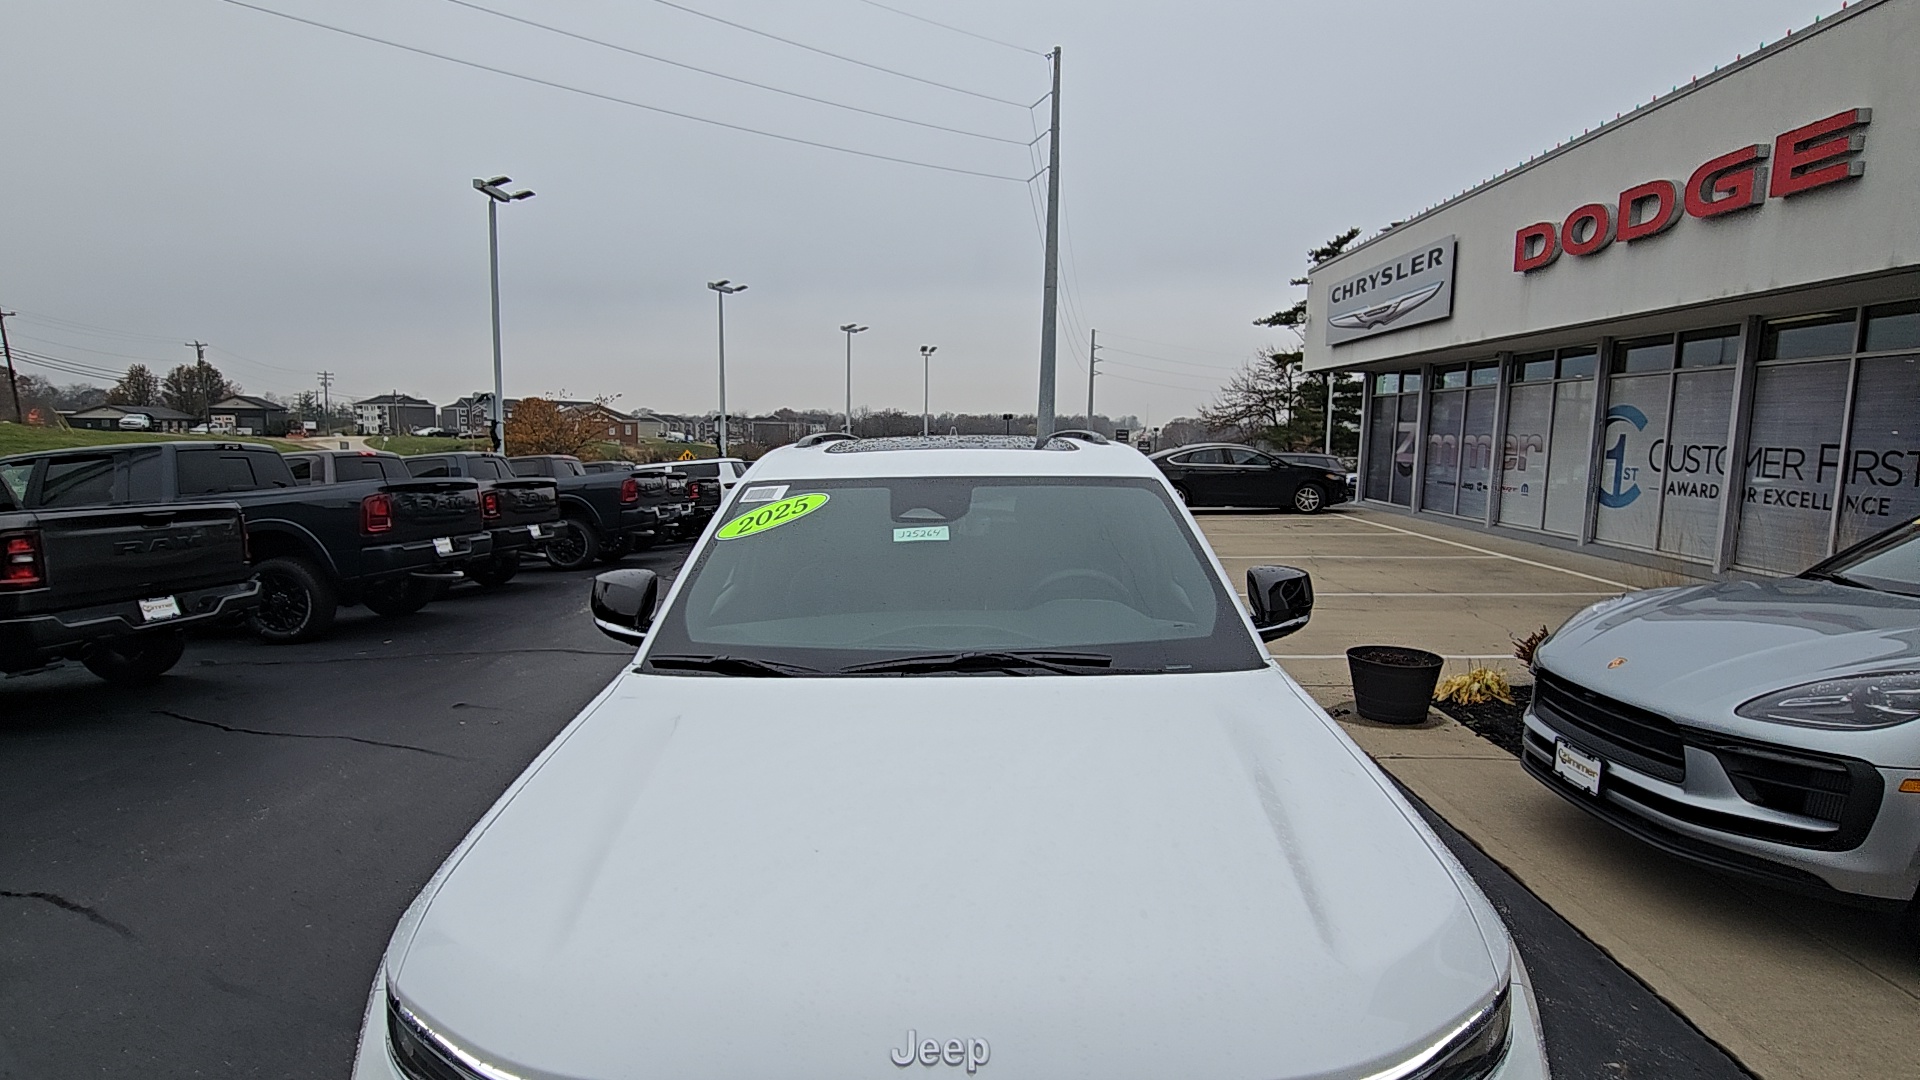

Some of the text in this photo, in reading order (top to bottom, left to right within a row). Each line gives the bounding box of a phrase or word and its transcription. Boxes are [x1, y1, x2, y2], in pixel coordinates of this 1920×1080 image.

[1514, 107, 1873, 273] DODGE
[1331, 247, 1444, 304] CHRYSLER
[1396, 421, 1544, 471] Zmmer
[736, 497, 810, 535] 2025
[1666, 480, 1720, 499] AWARD
[1762, 488, 1891, 517] EXCELLNCE
[113, 534, 203, 556] RAM
[890, 1029, 991, 1075] Jeep
